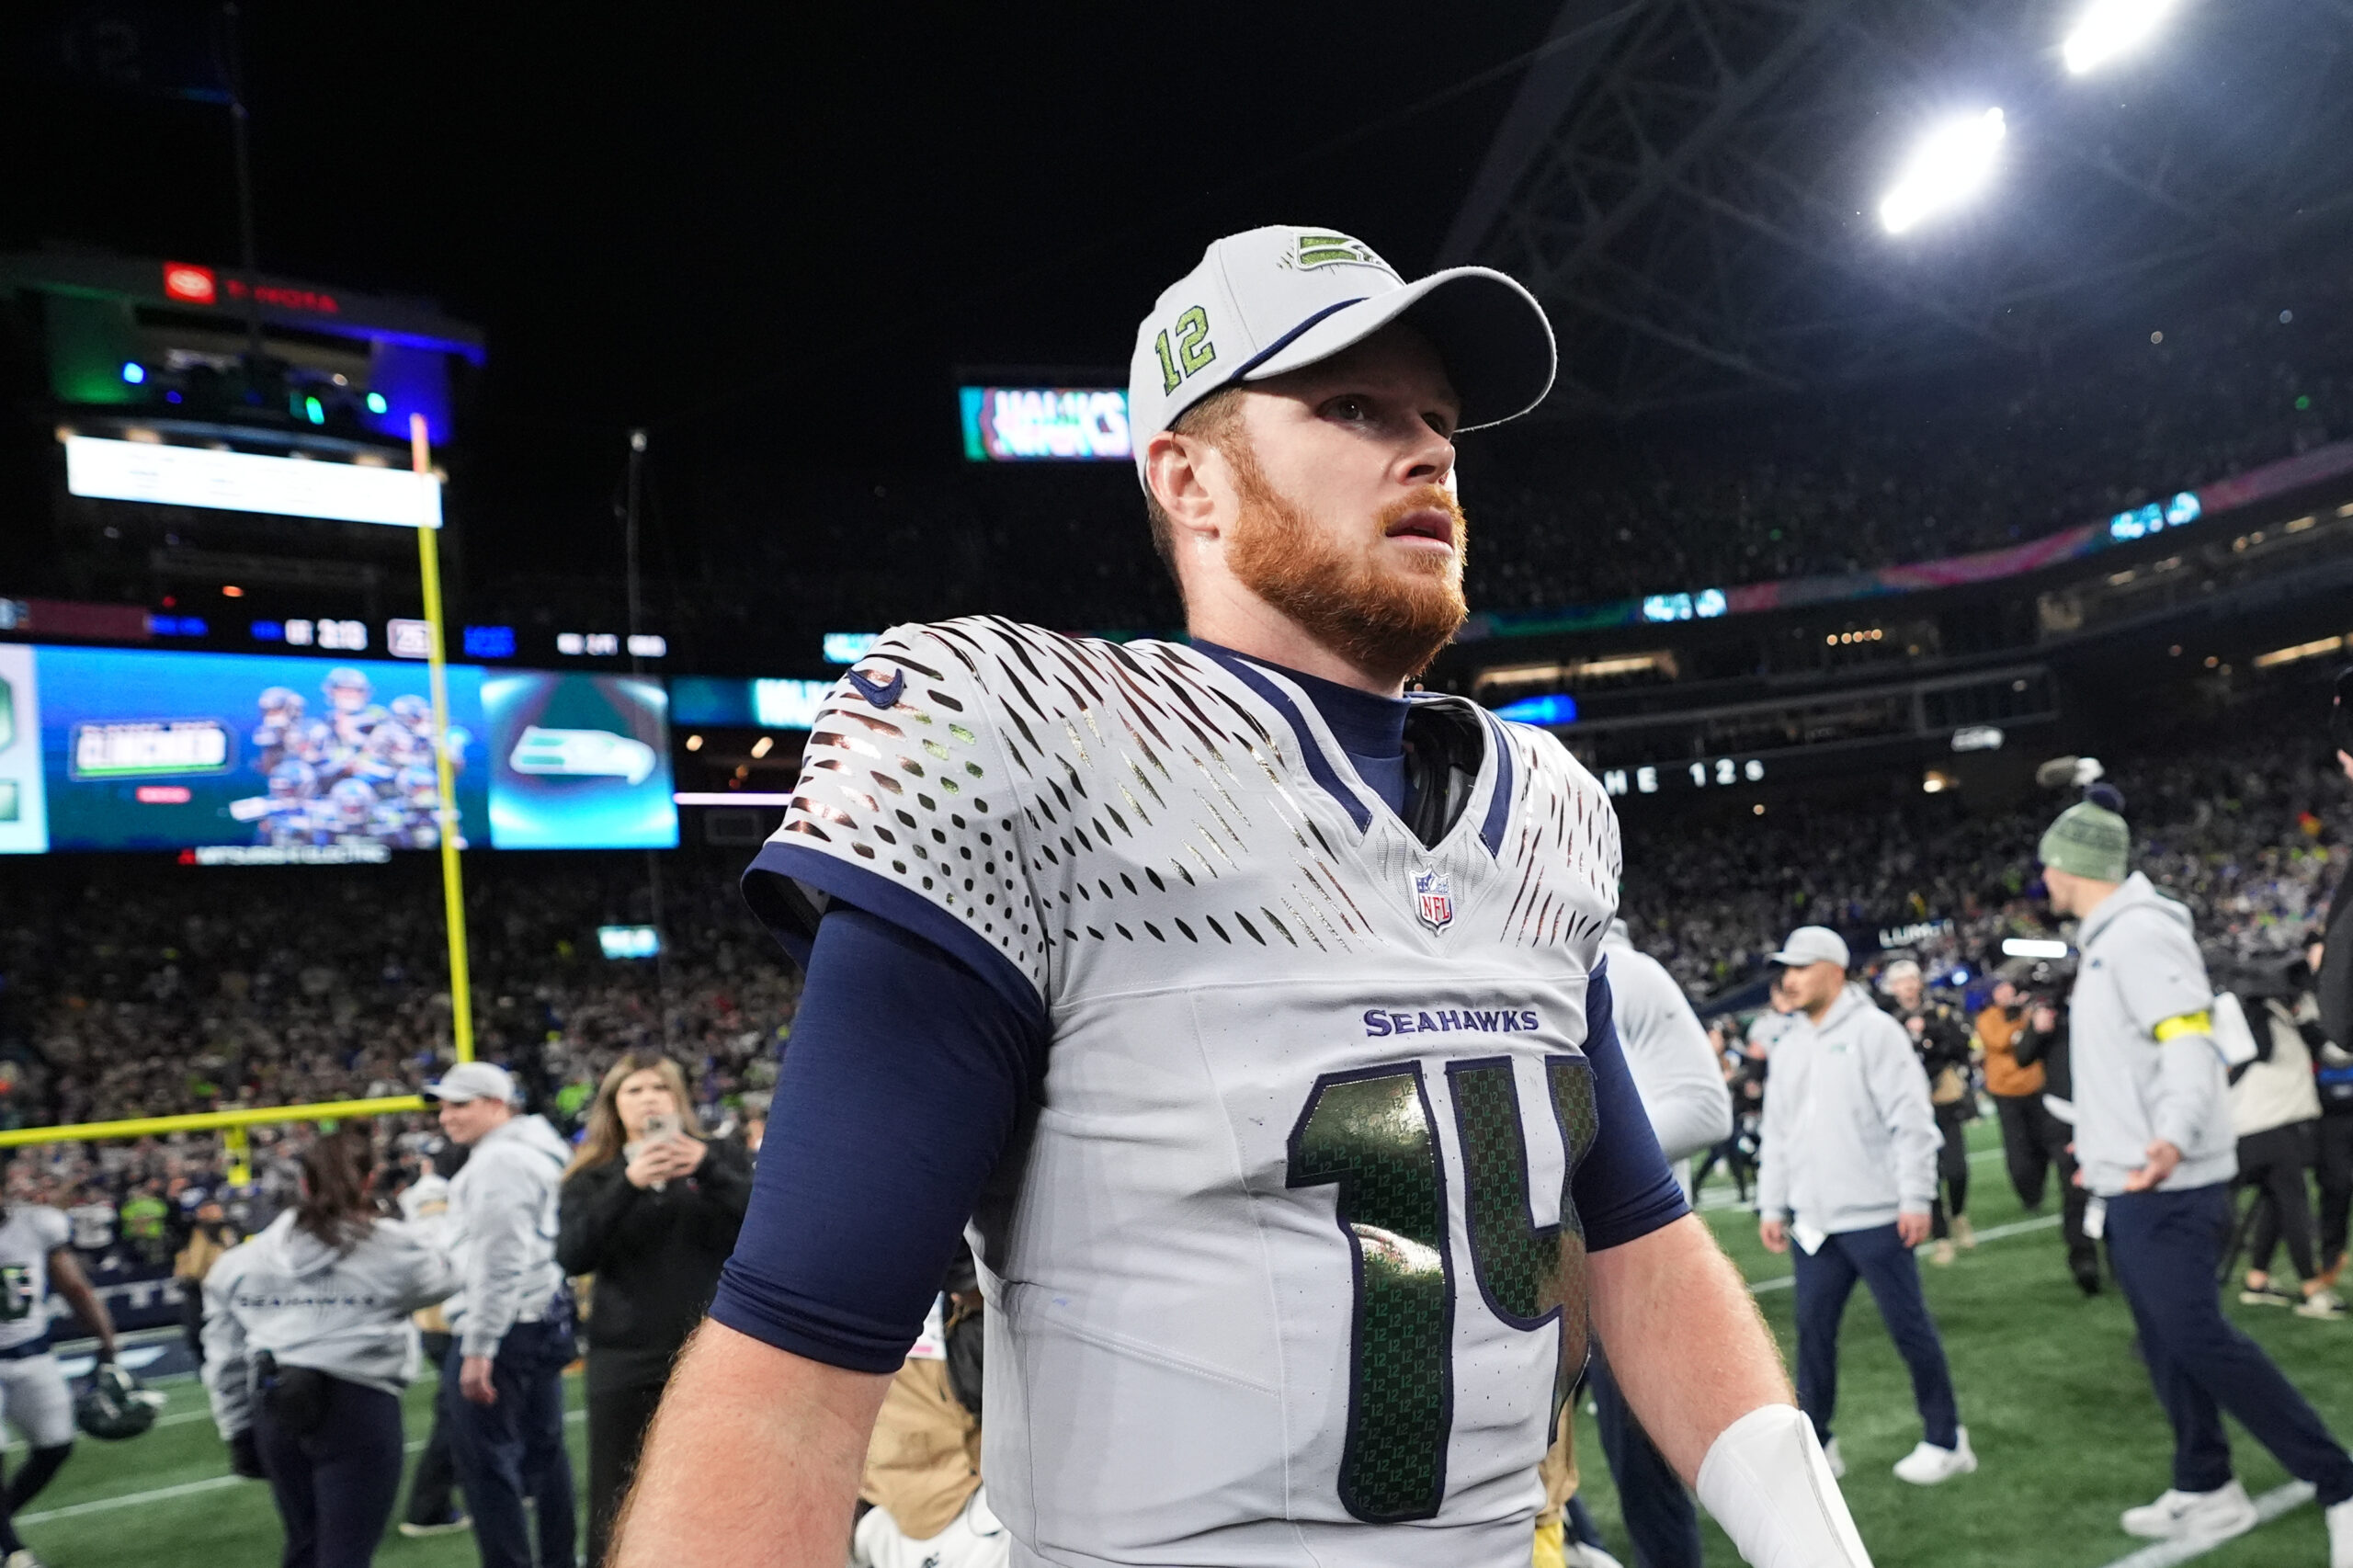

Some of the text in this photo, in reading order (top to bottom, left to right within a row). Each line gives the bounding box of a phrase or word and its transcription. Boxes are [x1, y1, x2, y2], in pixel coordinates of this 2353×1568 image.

[1155, 305, 1216, 397] 12
[1421, 895, 1450, 922] NFL
[1363, 1008, 1540, 1038] SEAHAWKS
[1285, 1054, 1599, 1523] 14
